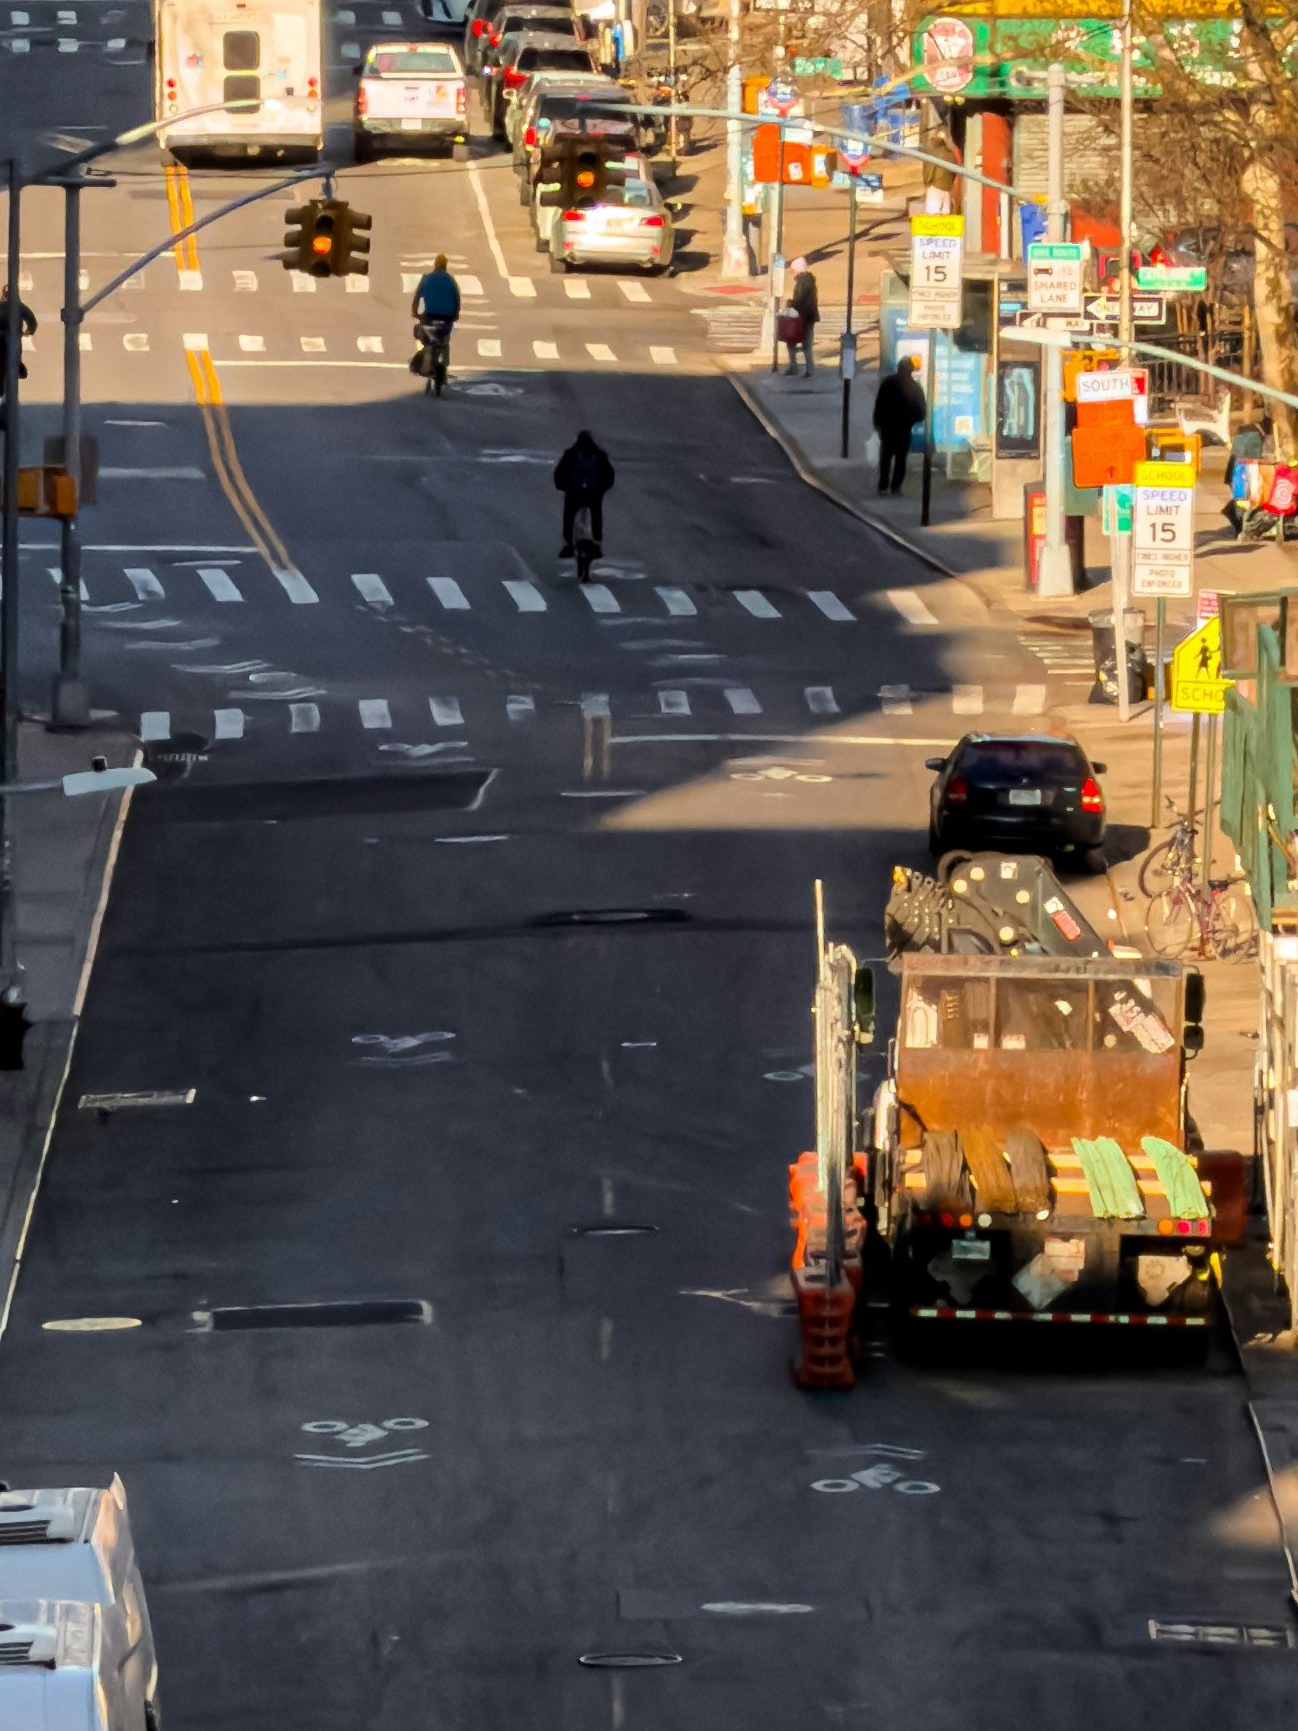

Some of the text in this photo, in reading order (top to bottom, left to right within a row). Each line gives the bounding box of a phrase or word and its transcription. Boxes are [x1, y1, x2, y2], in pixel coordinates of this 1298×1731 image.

[919, 237, 957, 248] SPEED
[921, 250, 951, 261] LIMIT
[925, 265, 947, 283] 15
[1040, 293, 1069, 304] LANE
[1082, 378, 1129, 393] SOUTH
[1140, 469, 1188, 482] SCHOOL
[1141, 489, 1187, 502] SPEED
[1146, 505, 1181, 517] LIMIT
[1149, 522, 1177, 543] 15
